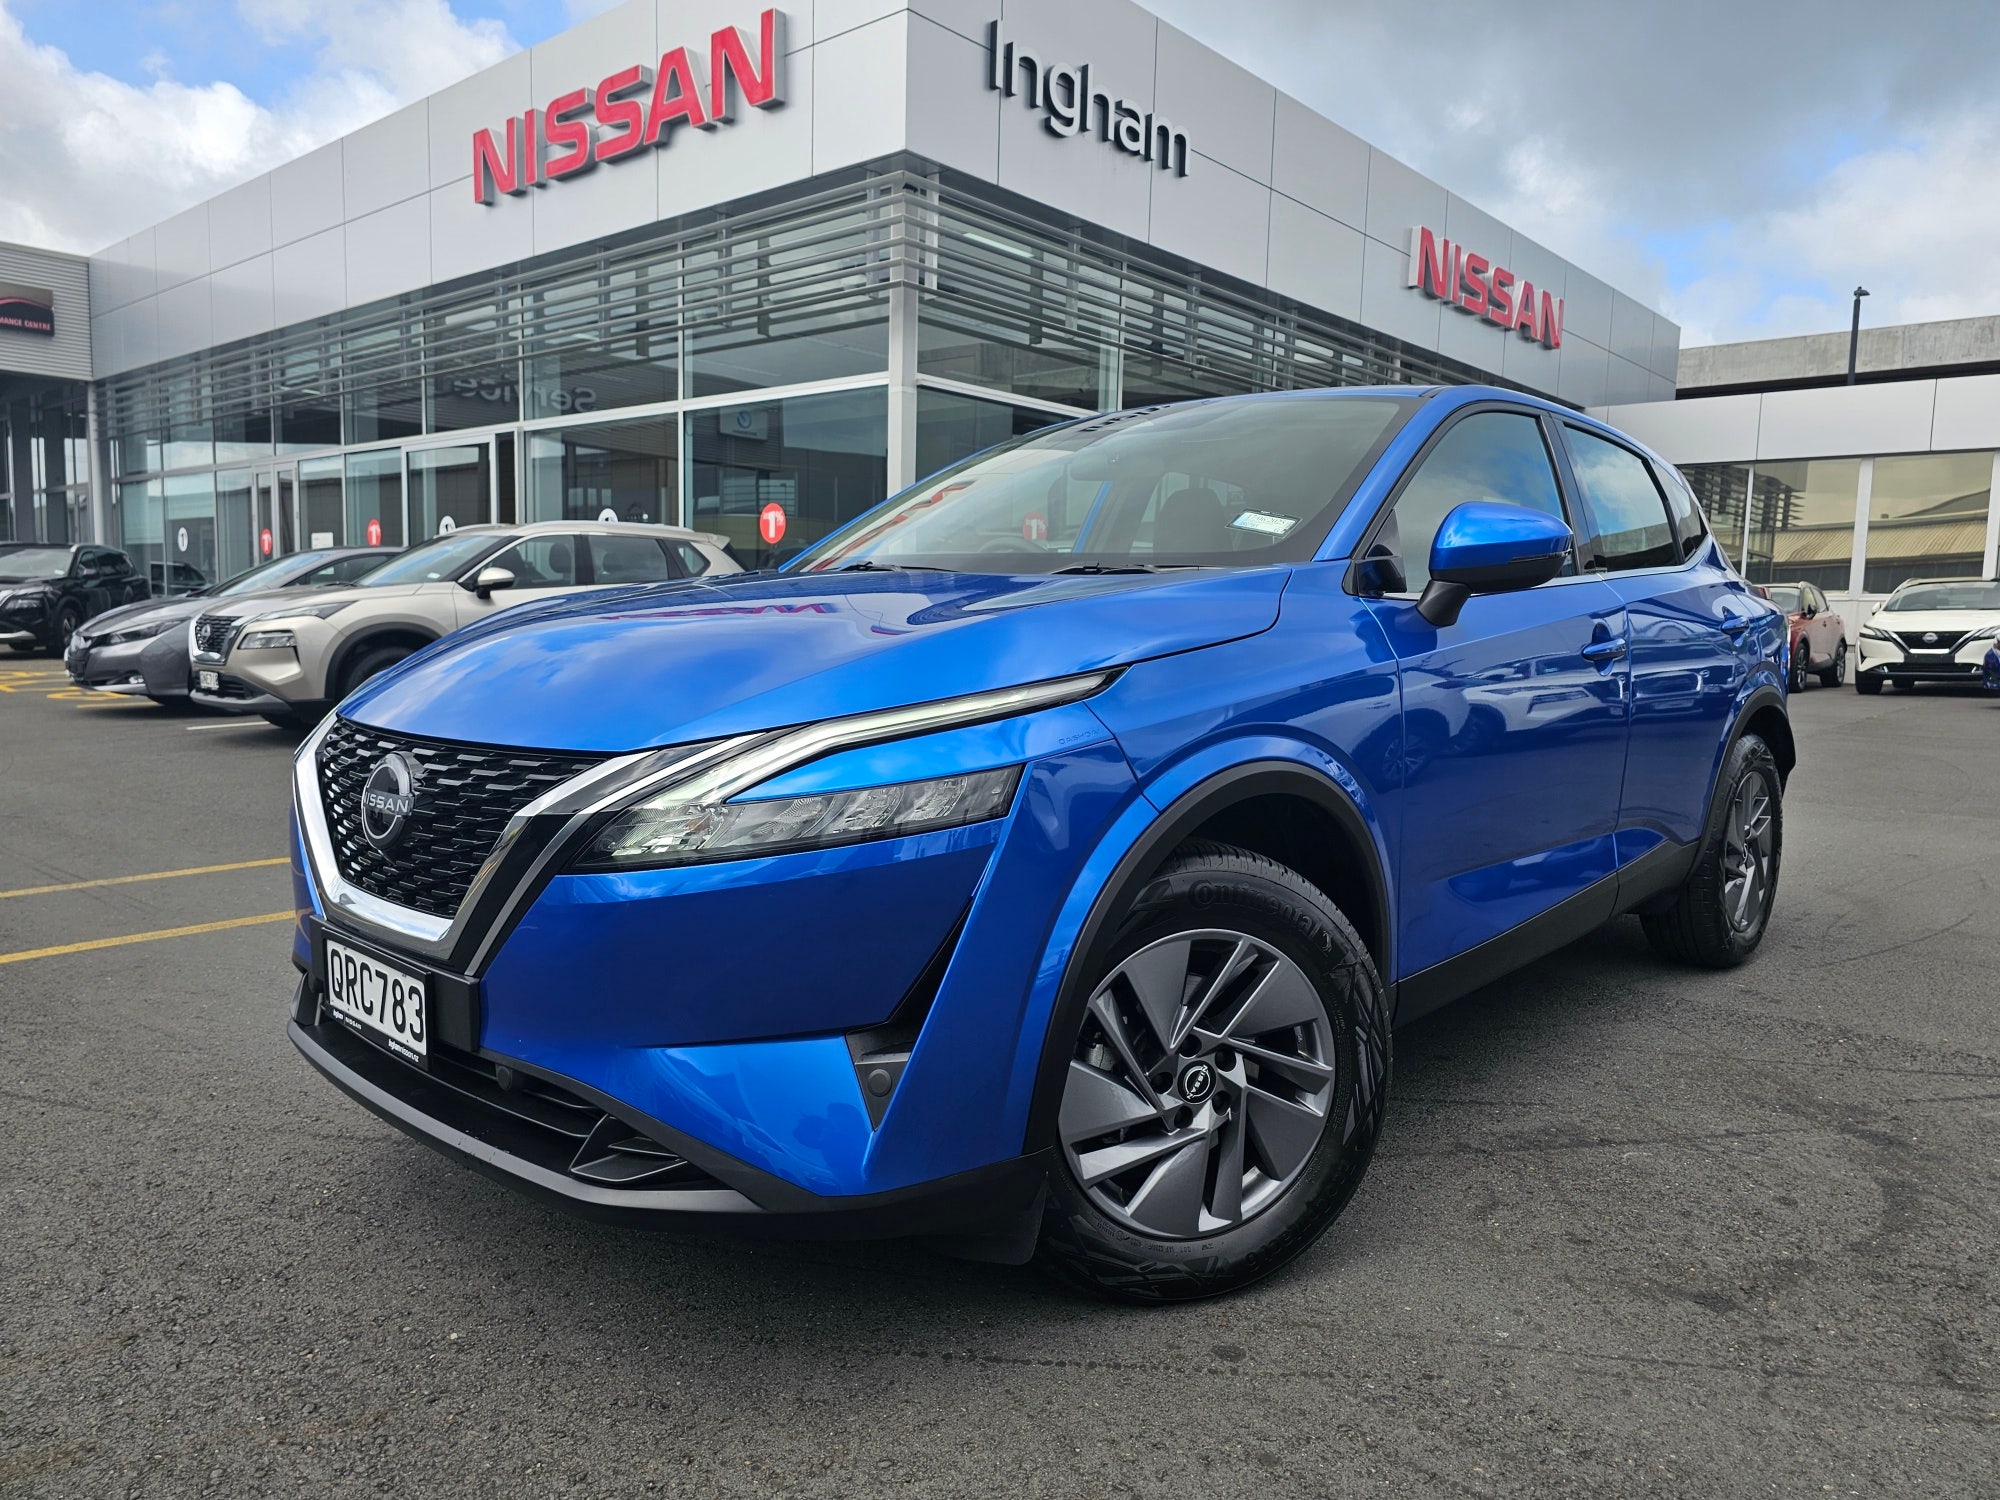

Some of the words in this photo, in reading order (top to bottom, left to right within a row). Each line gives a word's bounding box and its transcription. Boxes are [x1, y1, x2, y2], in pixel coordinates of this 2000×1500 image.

[473, 8, 778, 204] NISSAN
[990, 19, 1190, 177] Ingham
[1410, 225, 1564, 349] NISSAN
[364, 791, 409, 812] NISSAN
[1188, 879, 1322, 937] Continental
[331, 948, 424, 1042] QRC783
[1186, 1064, 1208, 1099] NISSAN
